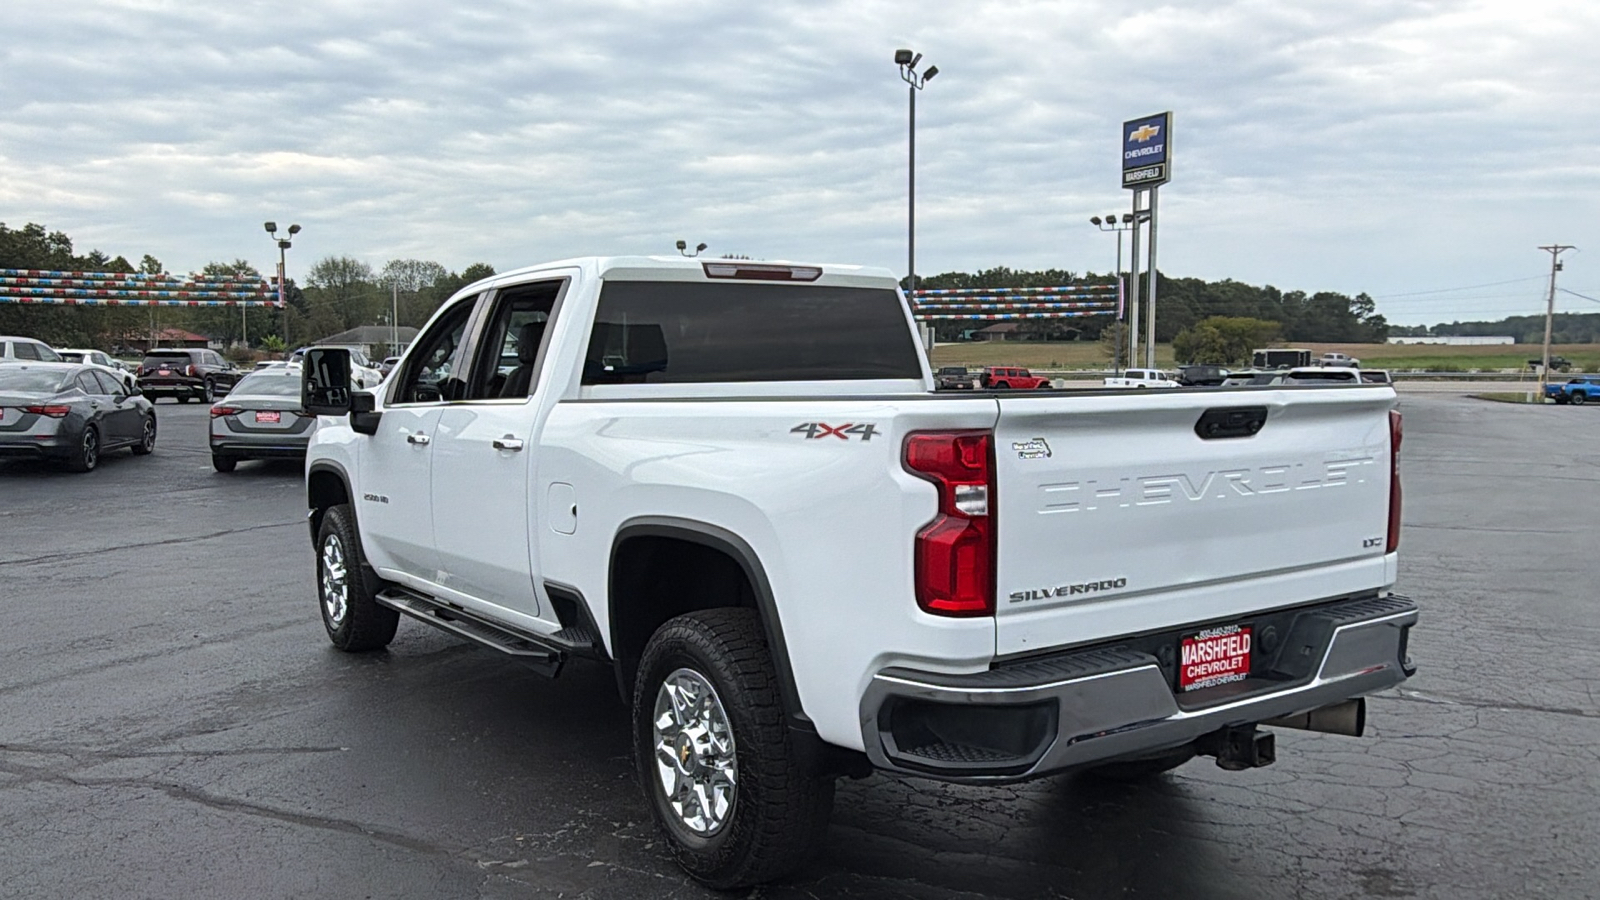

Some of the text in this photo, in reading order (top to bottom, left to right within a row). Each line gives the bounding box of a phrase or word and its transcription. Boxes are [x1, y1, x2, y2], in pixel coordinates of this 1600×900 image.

[1124, 144, 1164, 159] CHEVROLET
[1125, 168, 1160, 182] MARSHFIELD
[1037, 456, 1375, 514] CHEVROLET
[1009, 578, 1127, 603] SILVERADO
[1181, 633, 1251, 666] MARSHFIELD
[1187, 656, 1244, 678] CHEVROLET
[1185, 678, 1217, 692] MARSHFIELD
[1216, 673, 1247, 686] CHEVROLET
